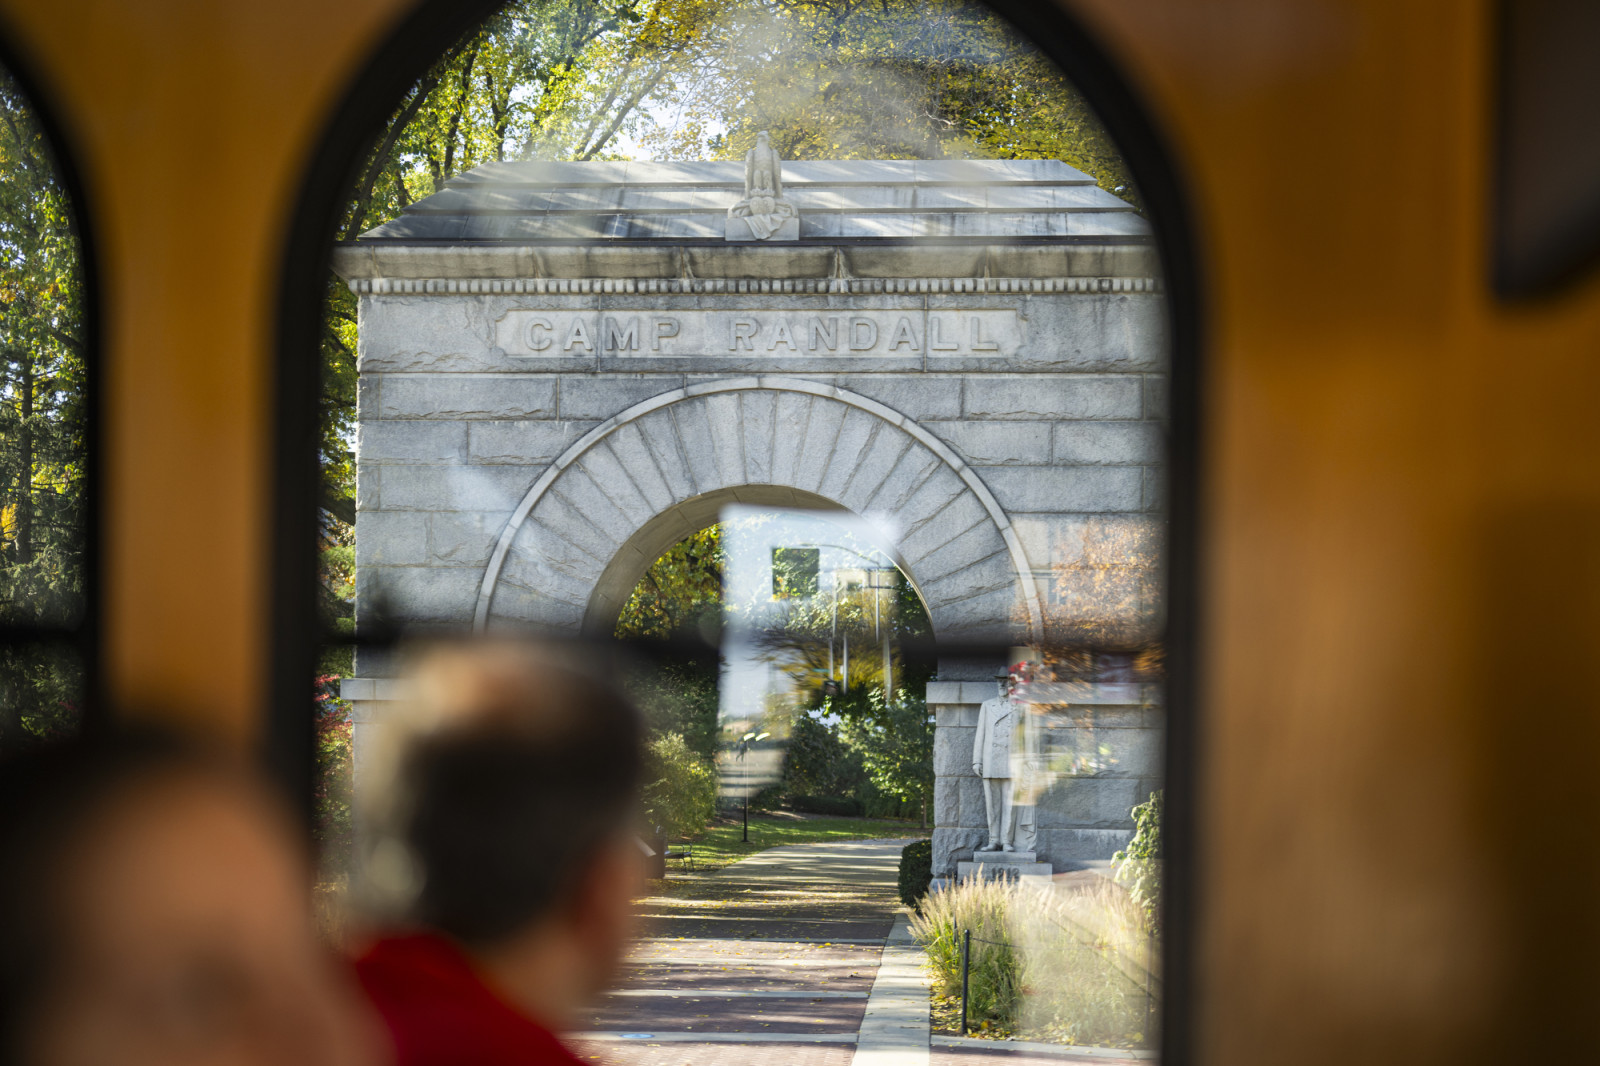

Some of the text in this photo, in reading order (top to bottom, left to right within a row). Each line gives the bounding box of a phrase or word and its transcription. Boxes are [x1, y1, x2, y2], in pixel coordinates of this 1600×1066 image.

[524, 317, 999, 351] CAMP RANDALL
[991, 867, 1020, 879] 1912
